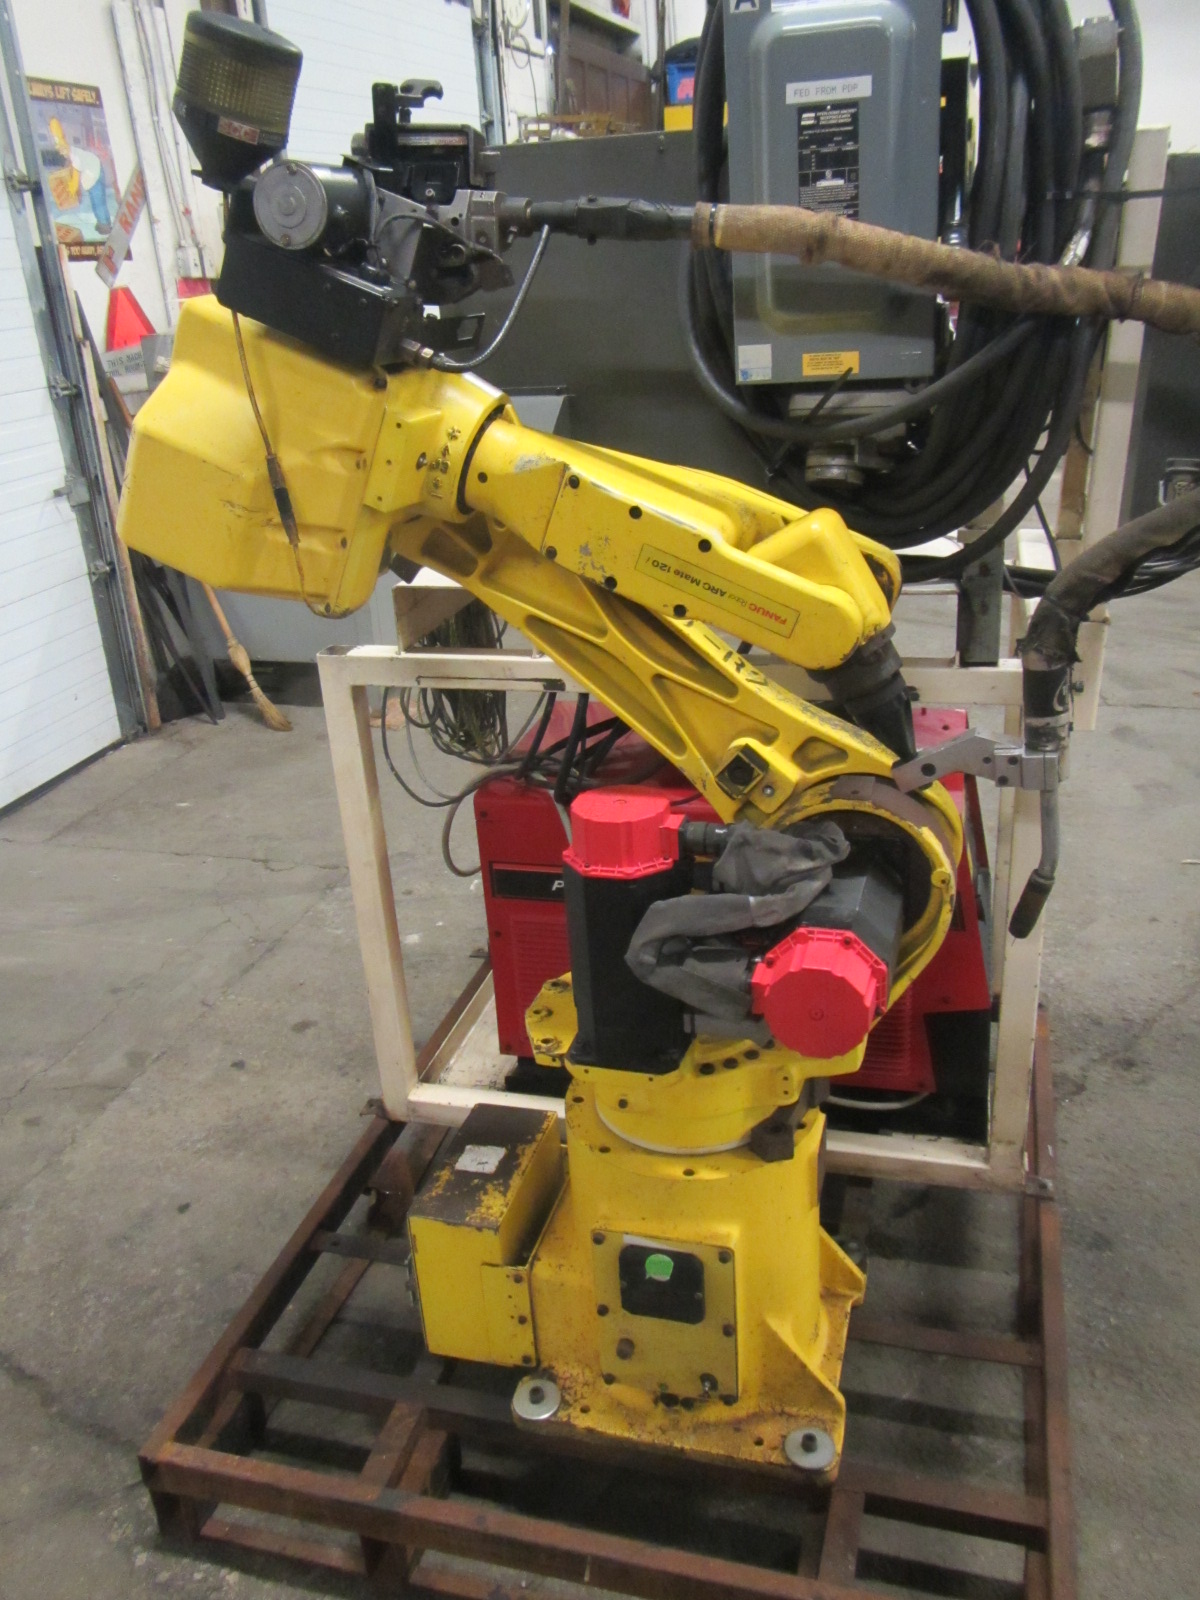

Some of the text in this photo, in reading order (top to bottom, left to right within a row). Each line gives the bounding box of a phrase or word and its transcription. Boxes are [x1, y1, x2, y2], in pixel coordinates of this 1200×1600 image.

[793, 88, 811, 98] FED
[815, 85, 837, 96] FROM
[652, 559, 672, 574] 120
[673, 569, 701, 587] Mate
[702, 582, 727, 597] ARC
[748, 602, 788, 626] FANUC
